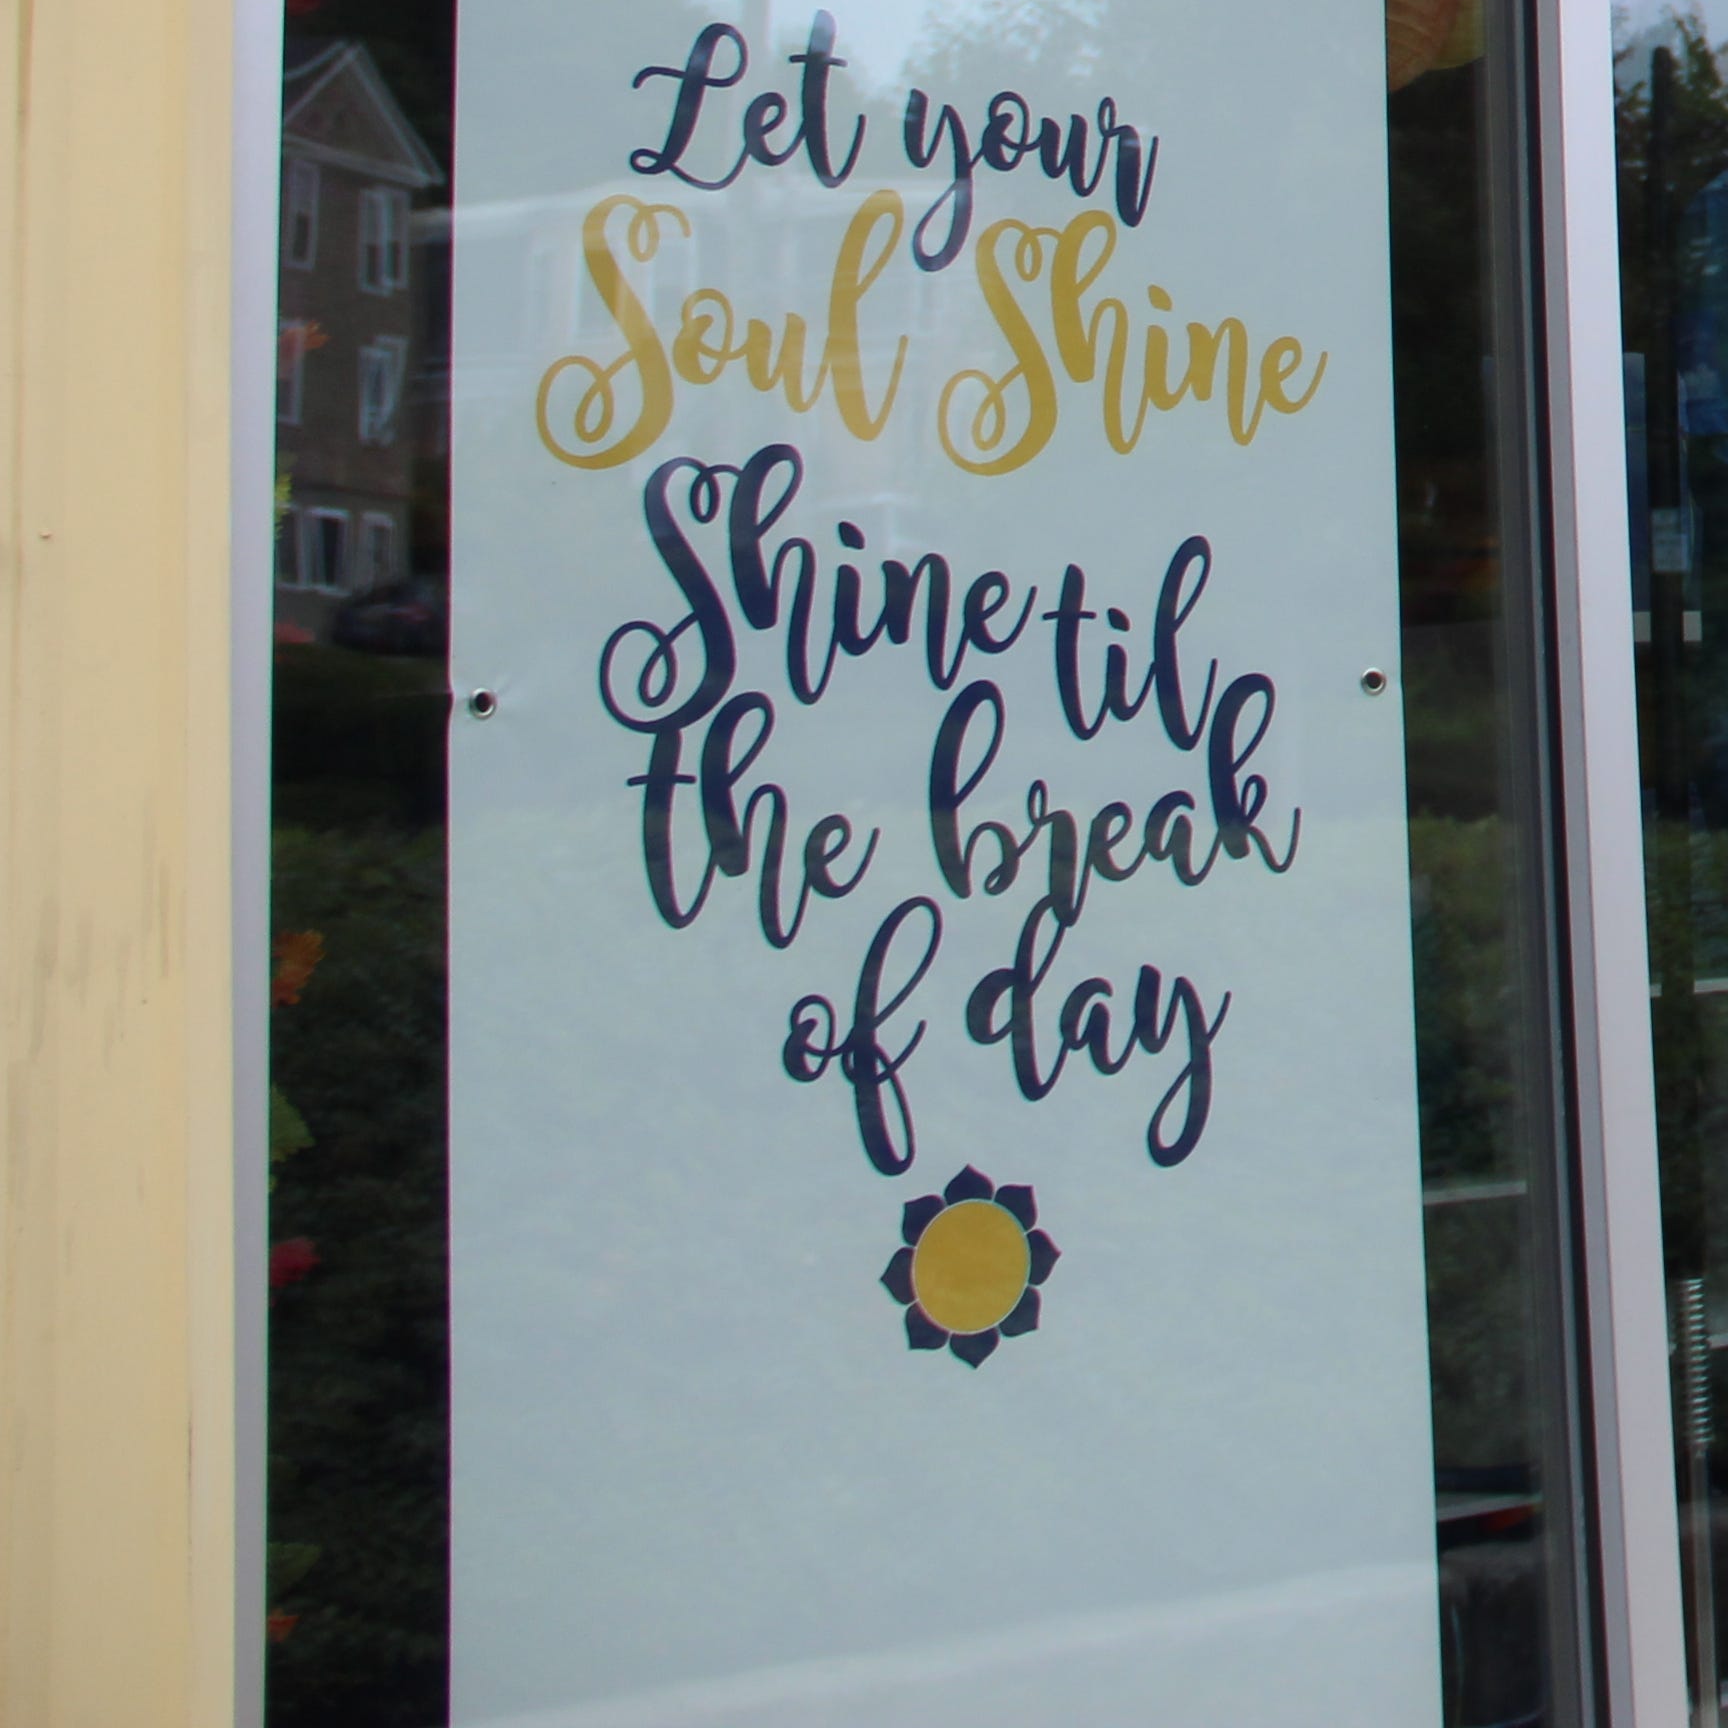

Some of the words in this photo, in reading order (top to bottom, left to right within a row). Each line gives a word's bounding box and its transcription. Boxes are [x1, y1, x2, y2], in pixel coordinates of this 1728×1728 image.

[629, 9, 866, 190] Let
[903, 87, 1159, 272] your
[536, 189, 908, 470] Soul
[938, 210, 1328, 476] Shine
[599, 443, 1038, 733] Shine
[1042, 535, 1218, 751] til
[626, 692, 879, 949] the
[929, 673, 1300, 927] break
[782, 896, 942, 1176] of
[965, 894, 1231, 1167] day
